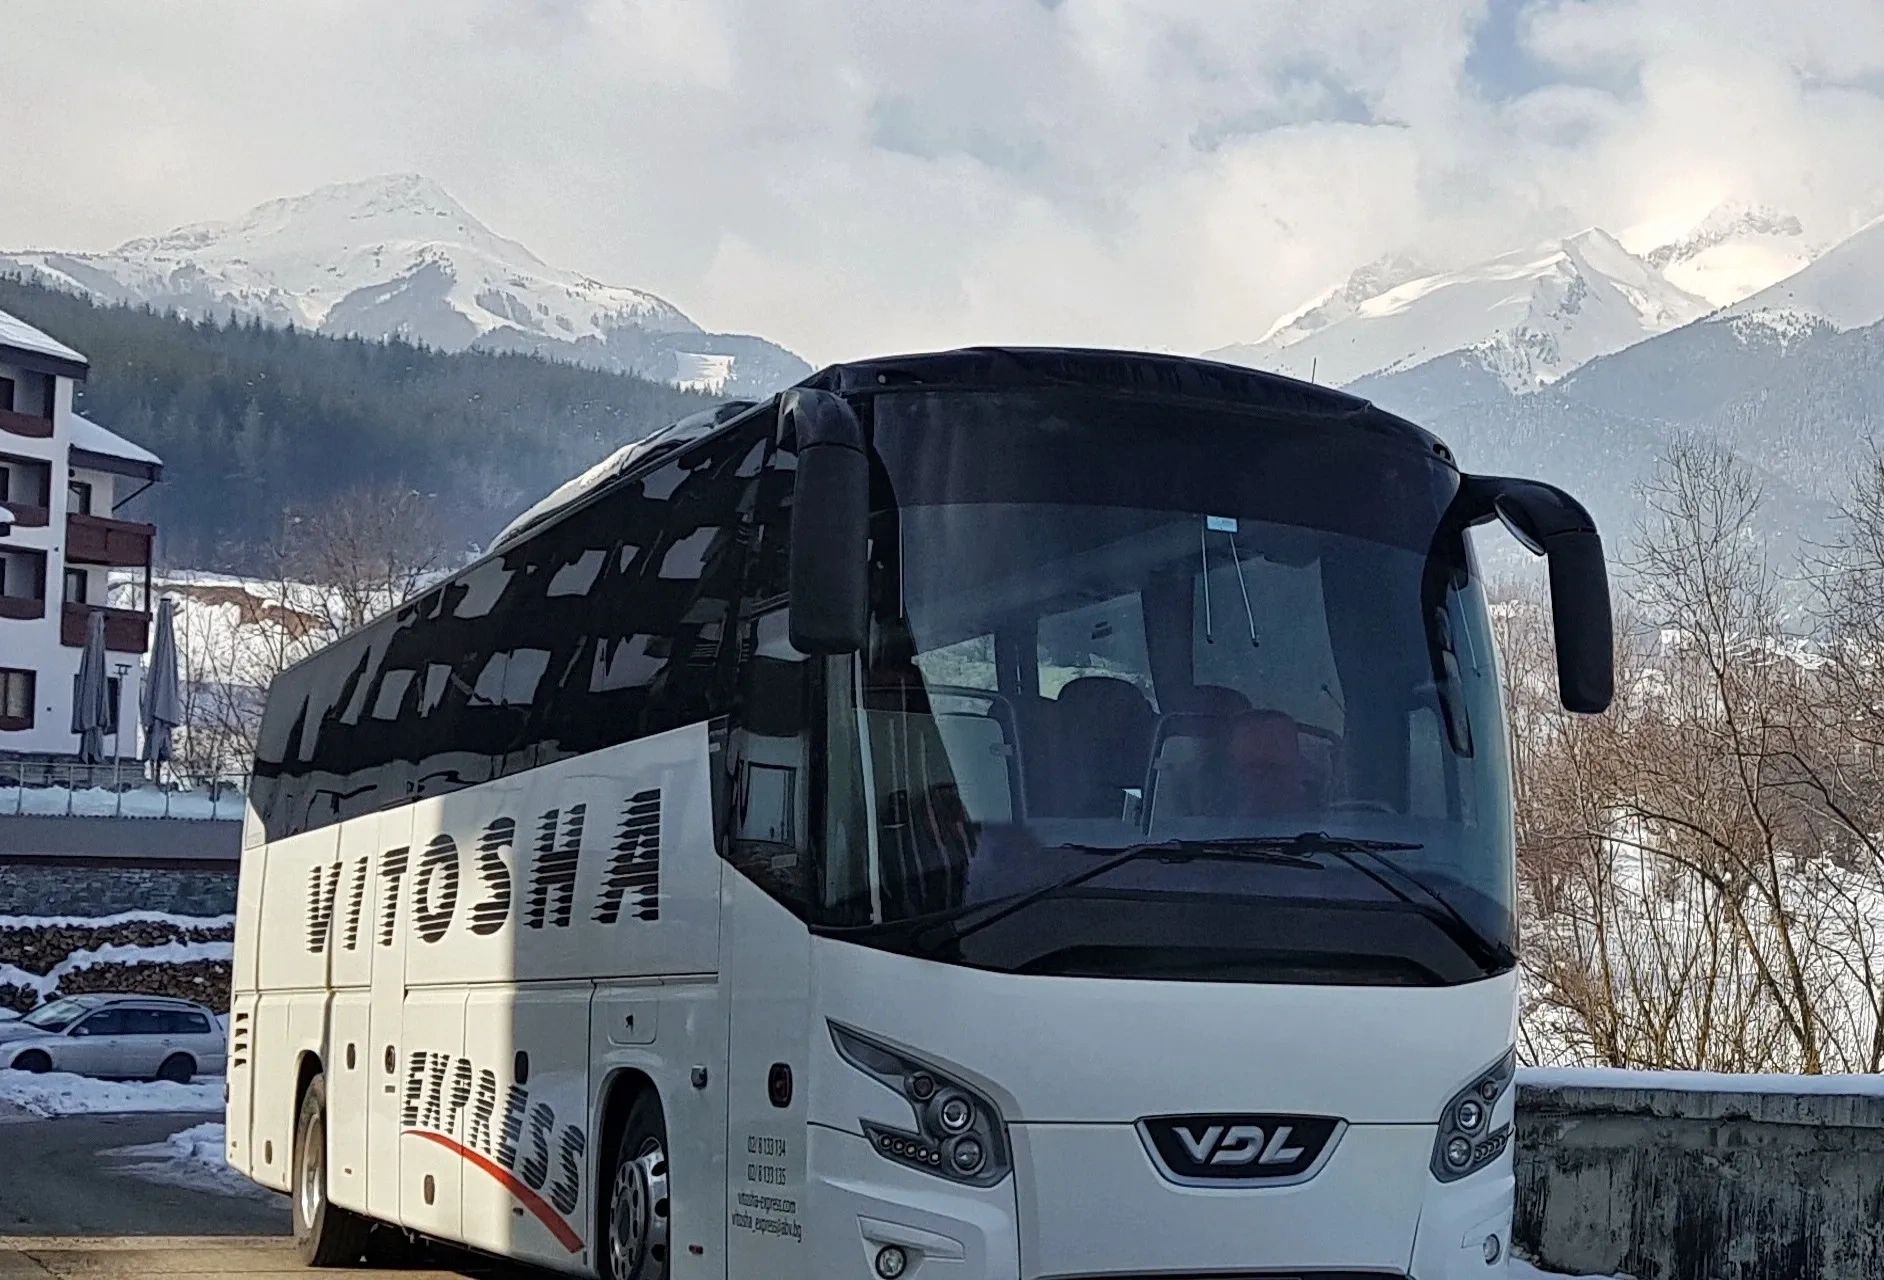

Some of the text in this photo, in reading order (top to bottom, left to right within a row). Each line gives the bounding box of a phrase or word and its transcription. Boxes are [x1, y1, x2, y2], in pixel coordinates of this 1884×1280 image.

[306, 788, 661, 953] VITOSHA
[401, 1051, 586, 1215] EXPRESS
[1171, 1125, 1305, 1165] VDL
